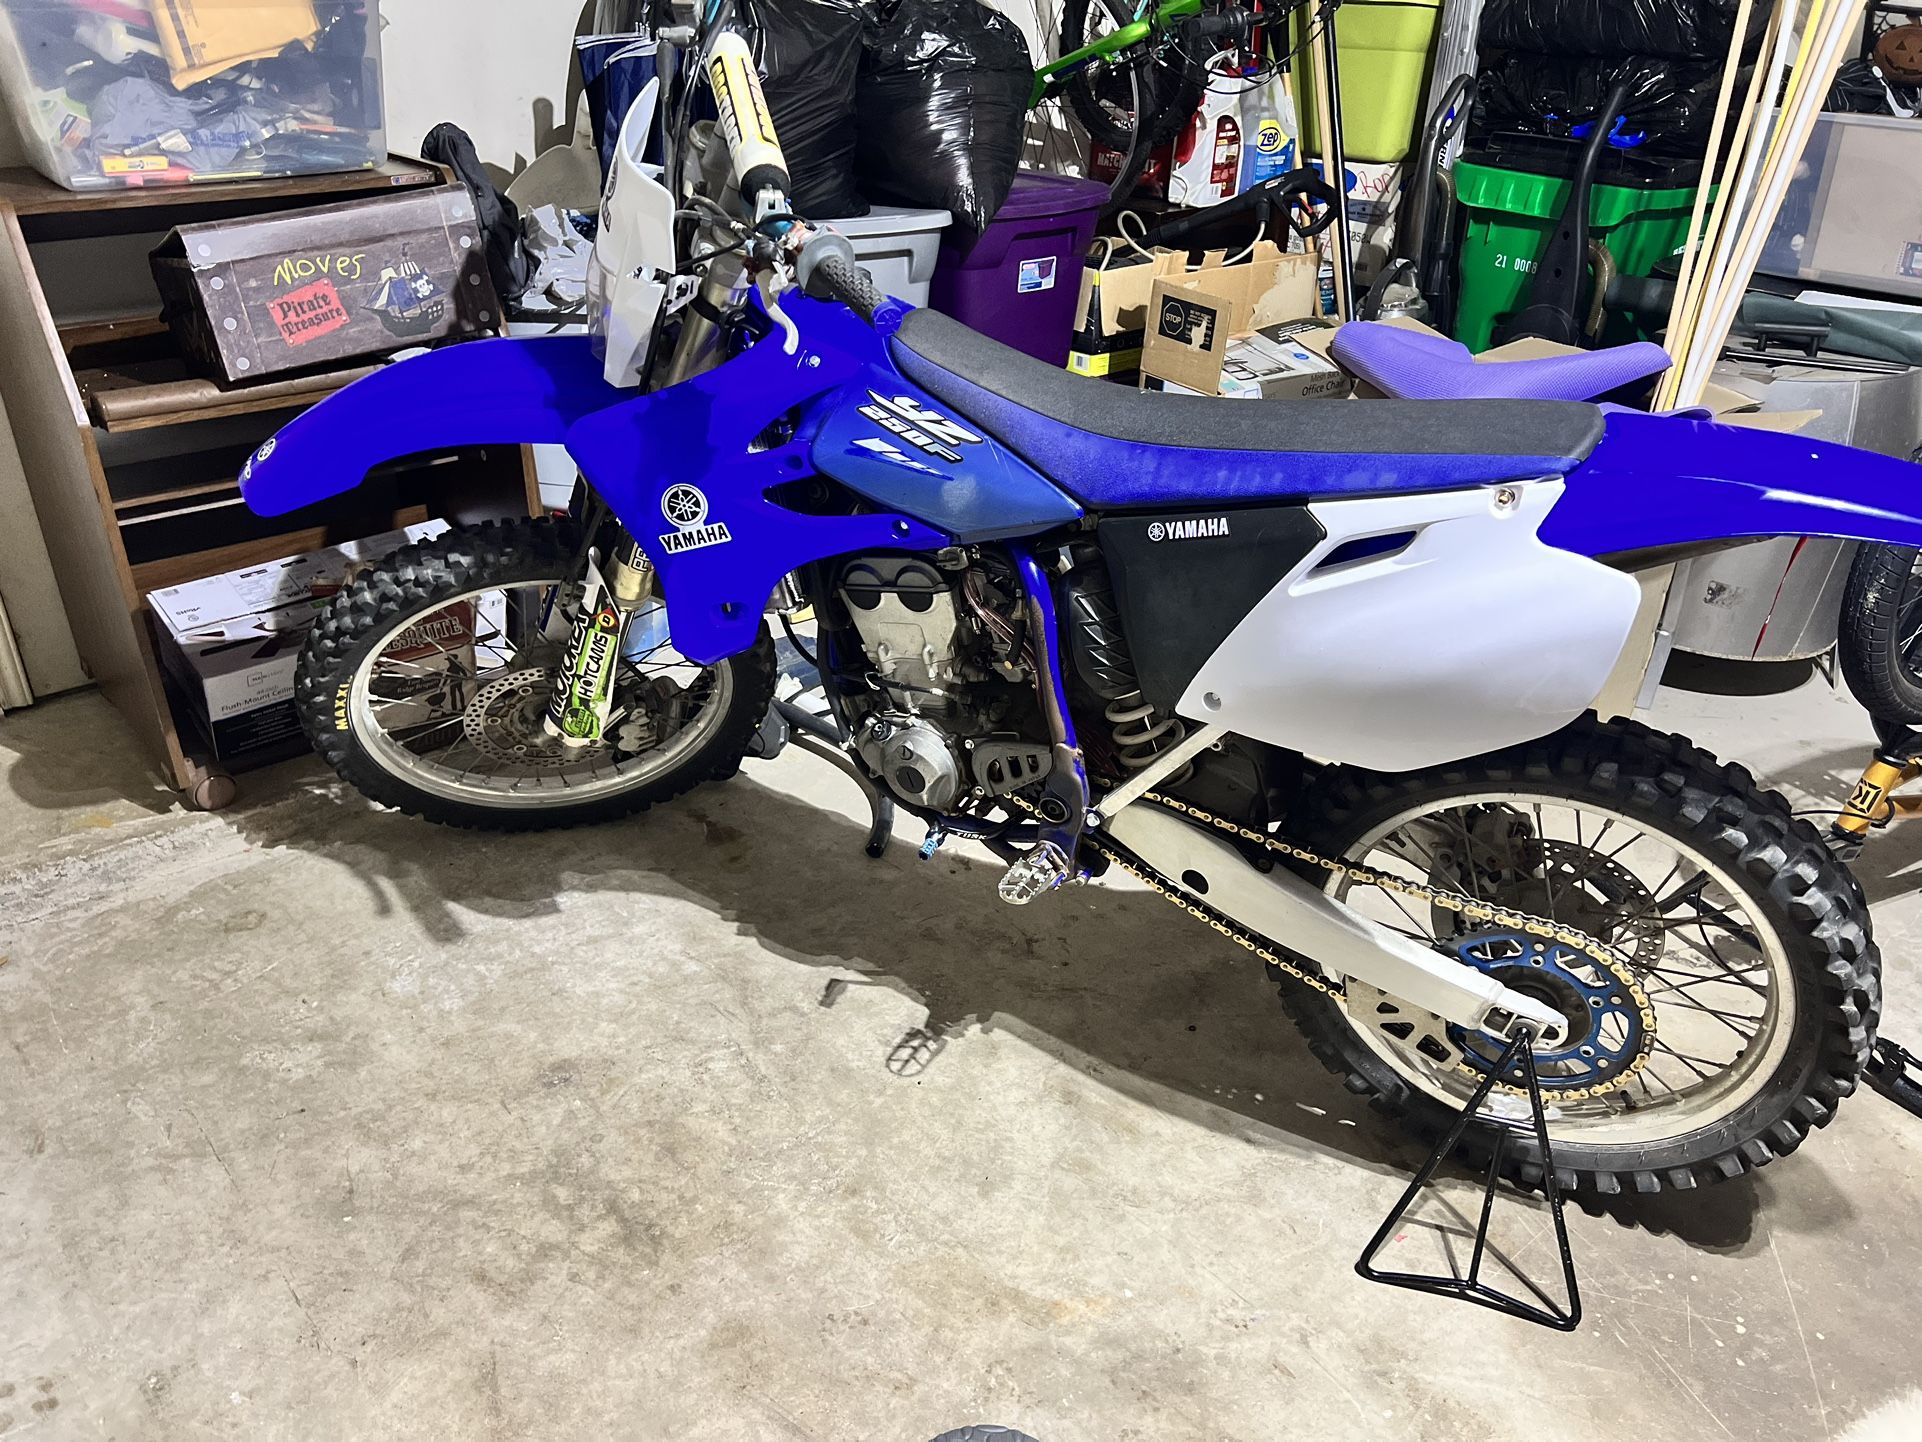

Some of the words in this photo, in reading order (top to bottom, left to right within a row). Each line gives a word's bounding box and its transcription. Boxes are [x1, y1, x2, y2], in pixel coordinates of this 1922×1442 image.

[273, 254, 366, 286] Moves
[1495, 254, 1507, 269] 21
[276, 291, 332, 321] Pirate
[1165, 312, 1182, 324] STOP
[282, 306, 343, 338] Treasure
[1301, 383, 1325, 397] Office
[866, 388, 983, 446] YZ
[856, 403, 964, 463] 250F
[660, 524, 729, 552] YAMAHA
[1165, 517, 1229, 540] YAMAHA
[578, 631, 609, 698] HOTCAMS
[271, 686, 295, 697] Ceilin
[956, 831, 988, 841] TUSK
